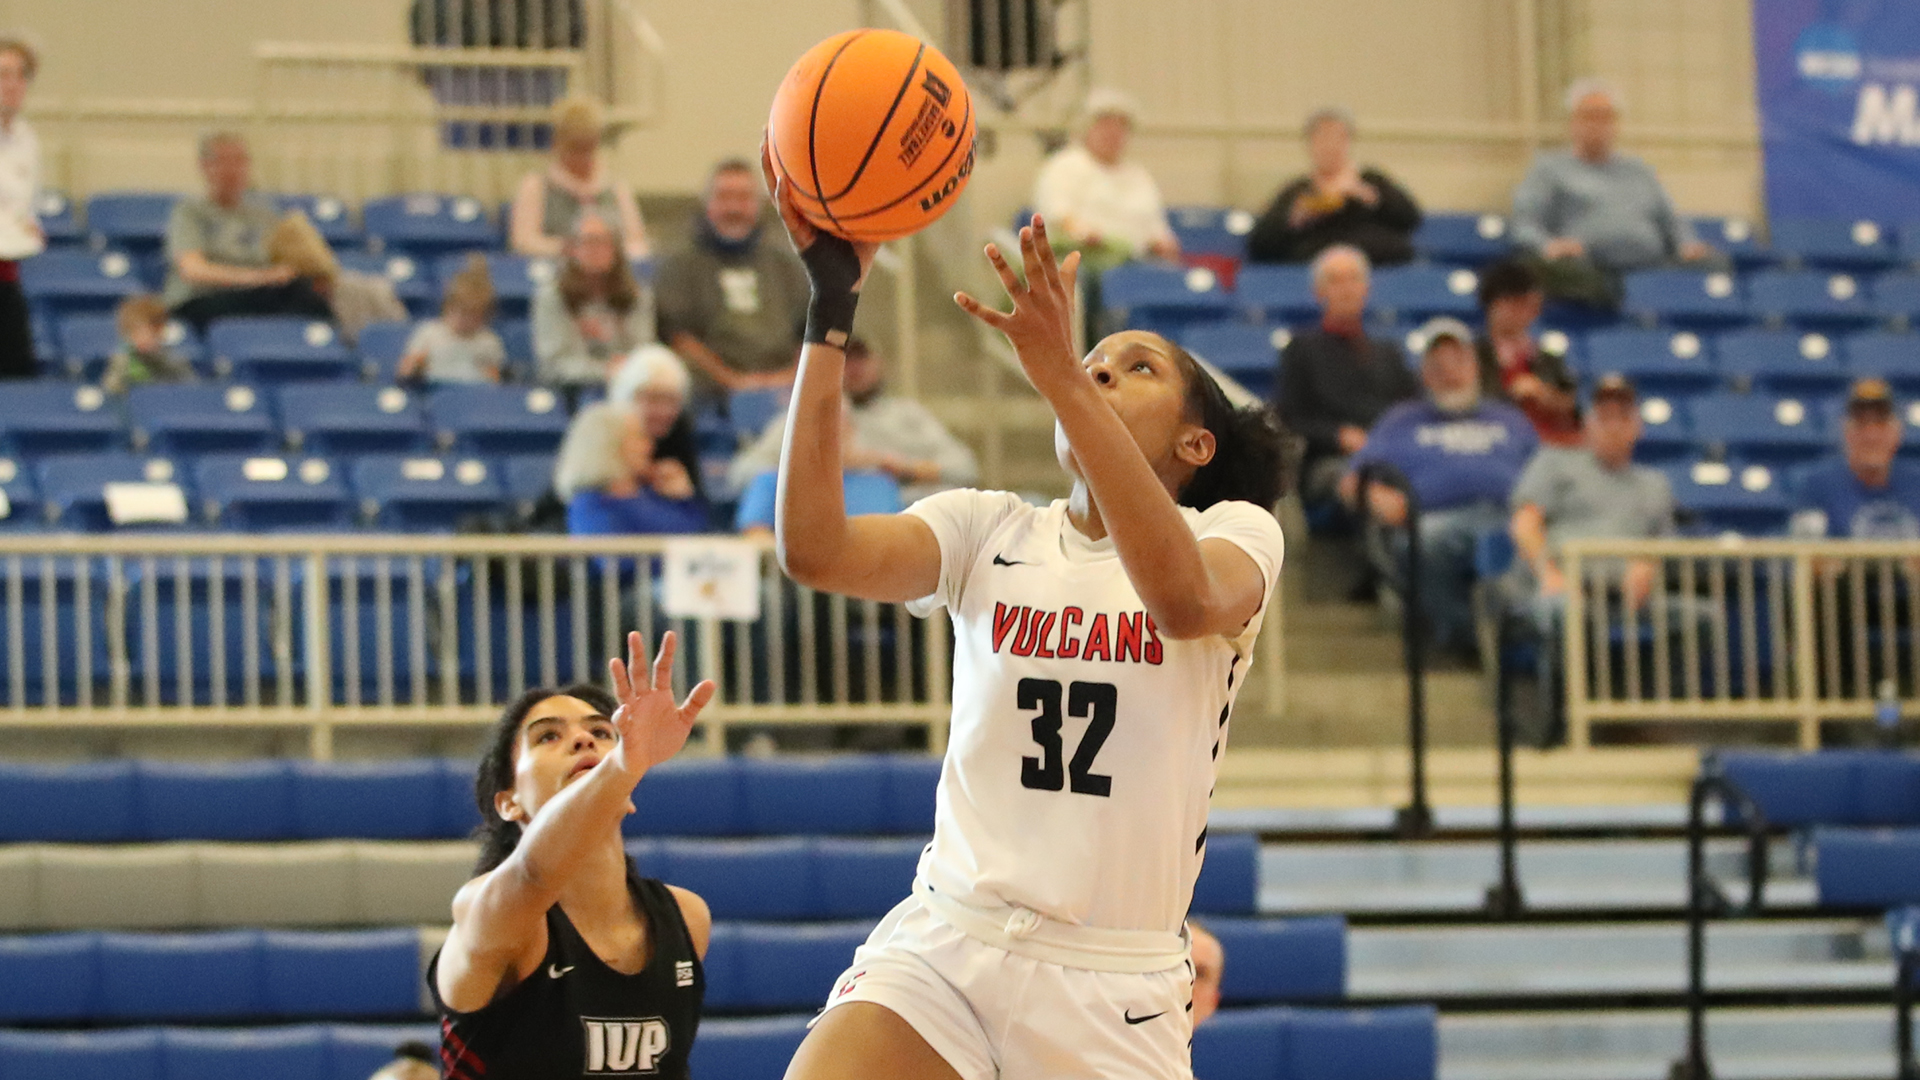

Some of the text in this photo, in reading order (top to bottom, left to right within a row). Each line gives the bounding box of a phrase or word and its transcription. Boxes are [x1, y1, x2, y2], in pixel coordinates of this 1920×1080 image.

[992, 601, 1163, 665] VULCANS
[1017, 677, 1117, 797] 32
[584, 1019, 670, 1073] IUP
